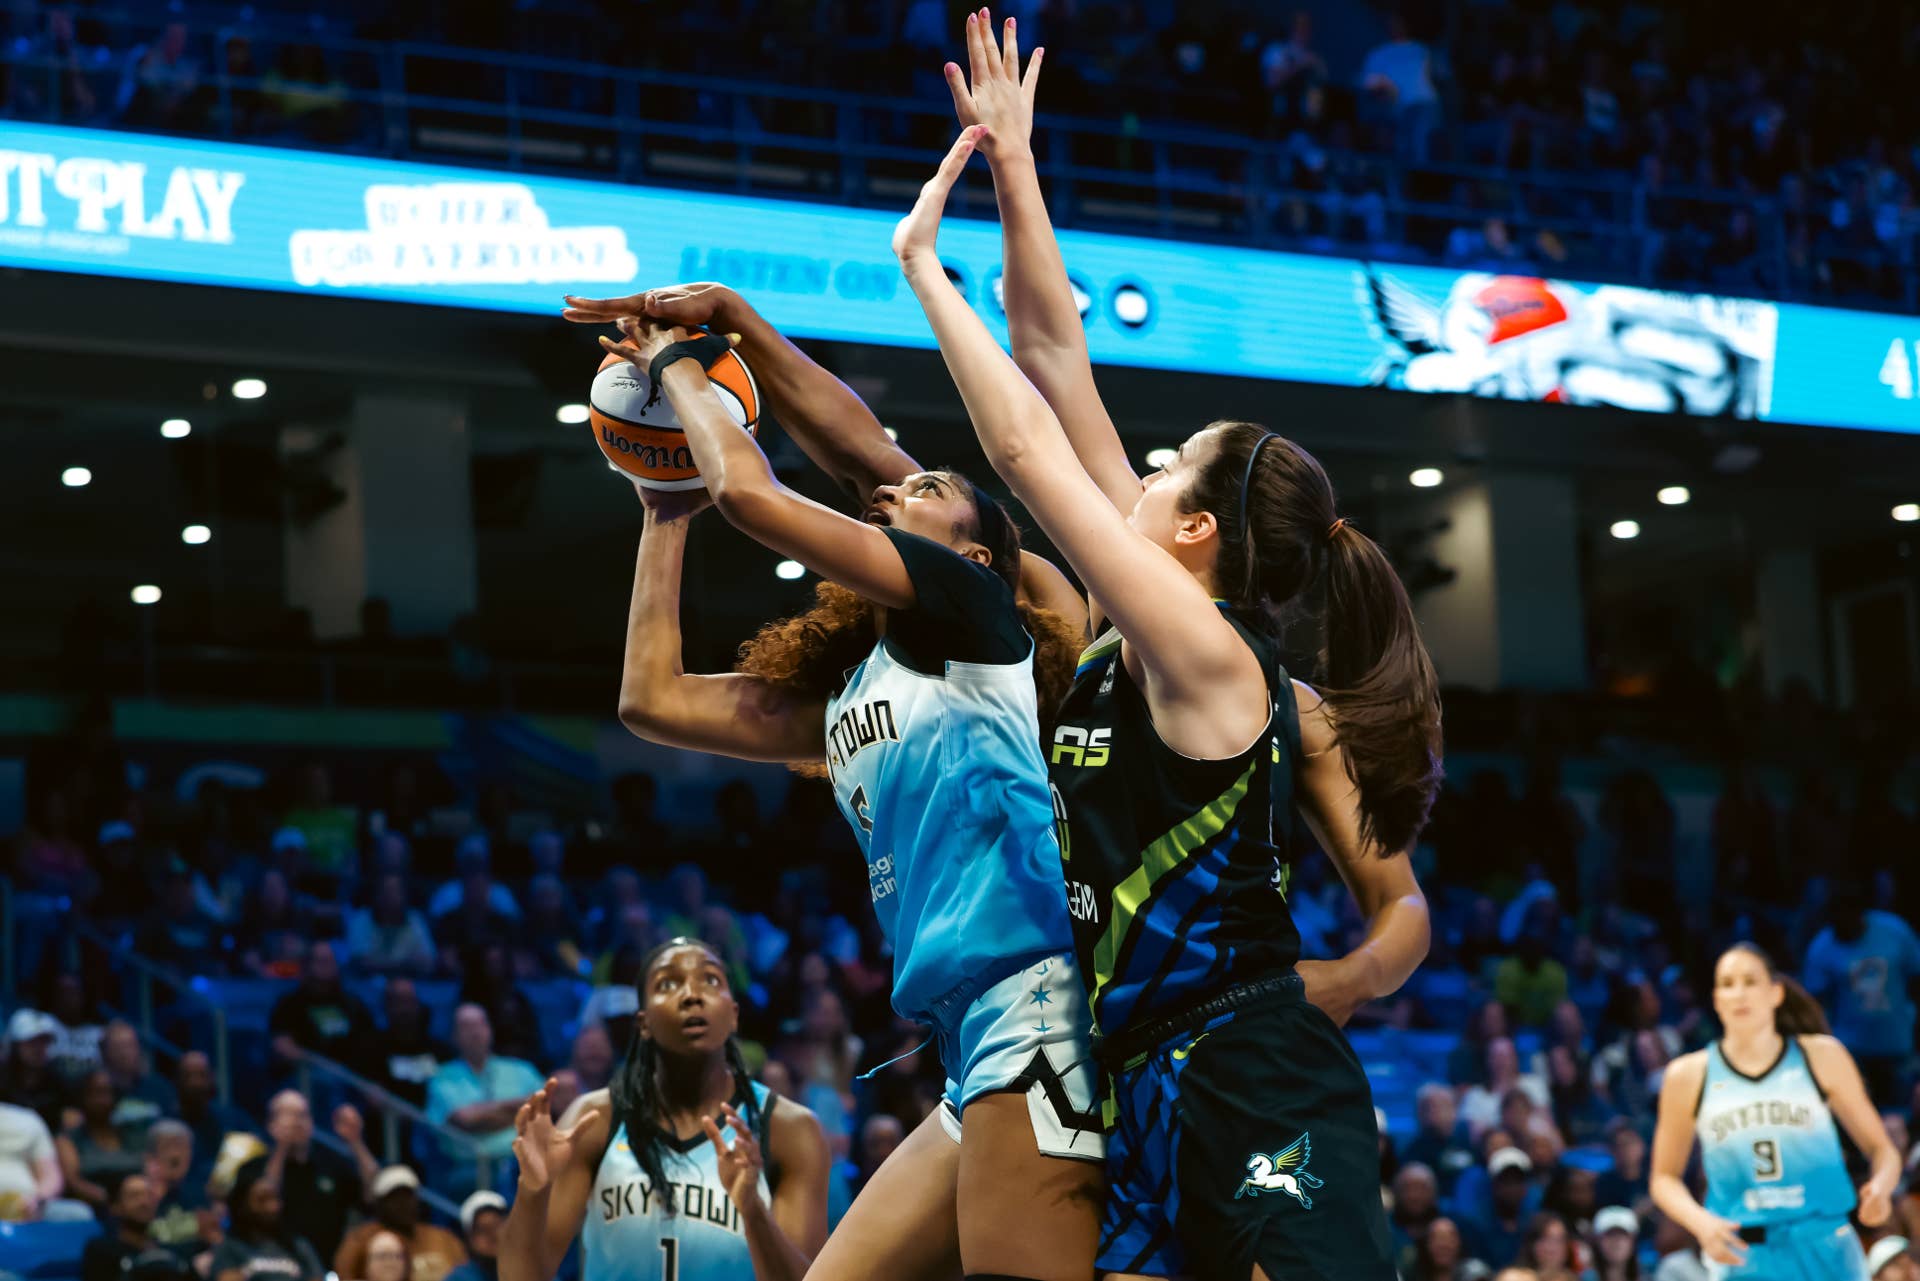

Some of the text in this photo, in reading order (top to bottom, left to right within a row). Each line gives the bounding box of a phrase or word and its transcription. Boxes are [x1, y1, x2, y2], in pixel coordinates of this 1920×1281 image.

[56, 157, 246, 245] PLAY
[1752, 1139, 1781, 1180] 9
[659, 1237, 678, 1281] 1
